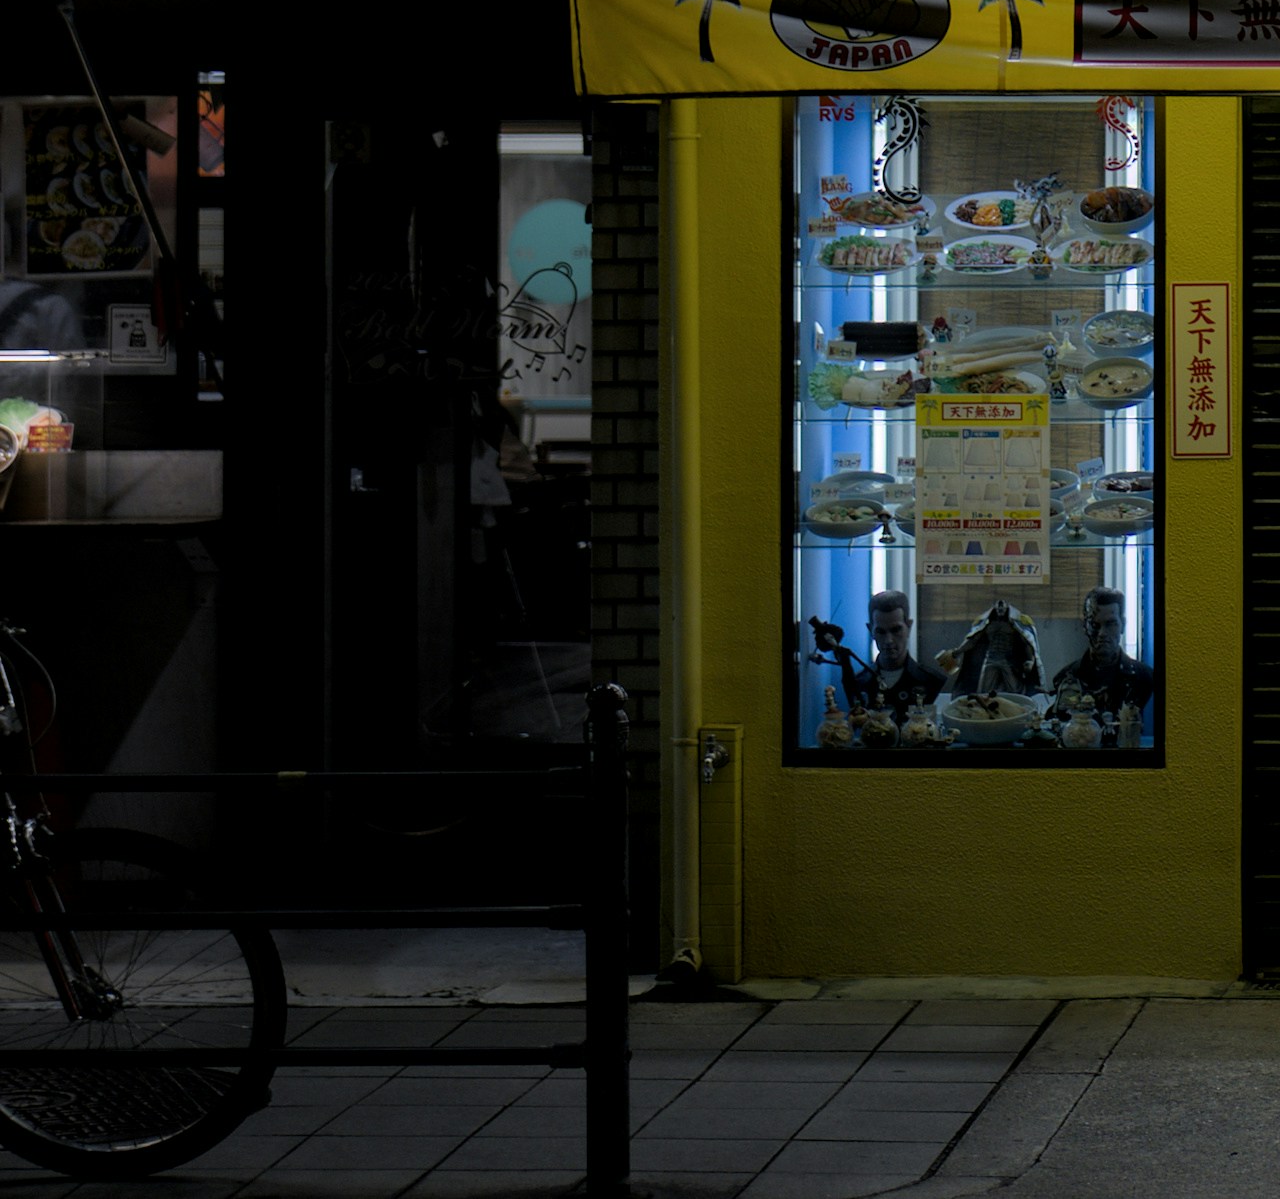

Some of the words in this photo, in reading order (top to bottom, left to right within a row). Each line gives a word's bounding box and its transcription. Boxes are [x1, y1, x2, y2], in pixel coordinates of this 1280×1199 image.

[806, 37, 913, 68] JAPAN
[1187, 299, 1217, 441] 天下無添加
[950, 405, 1015, 418] 天下無添加
